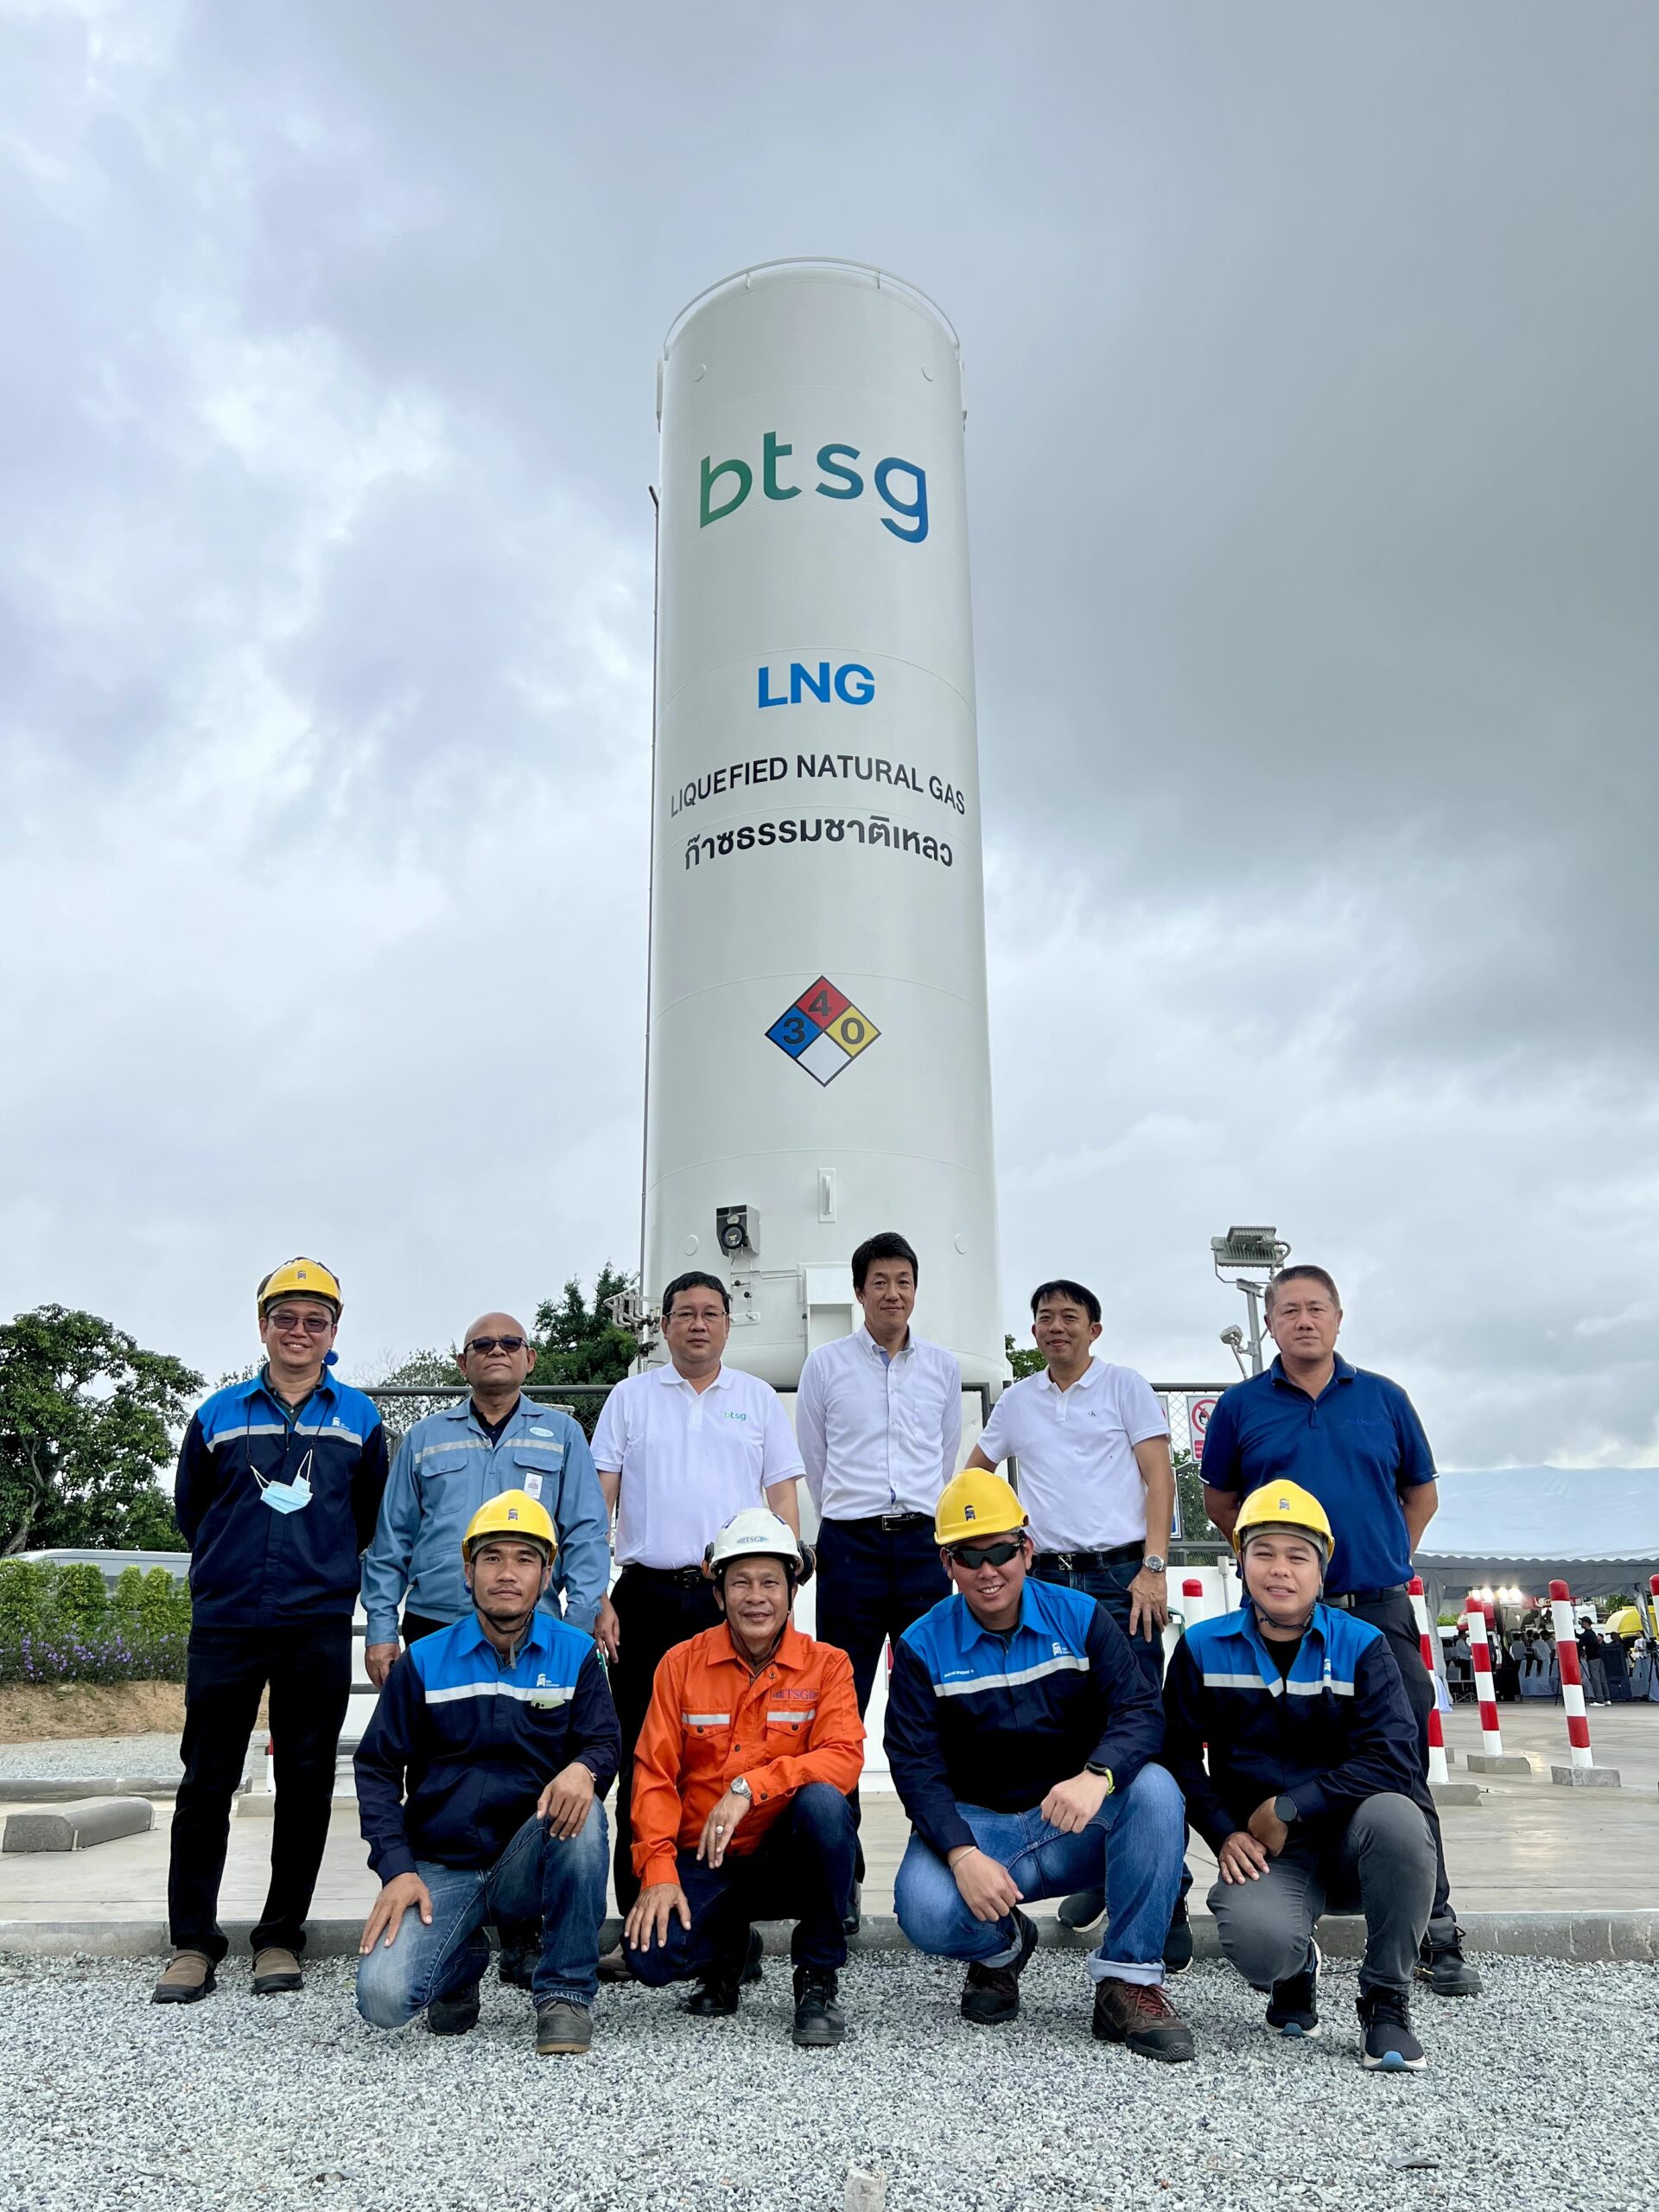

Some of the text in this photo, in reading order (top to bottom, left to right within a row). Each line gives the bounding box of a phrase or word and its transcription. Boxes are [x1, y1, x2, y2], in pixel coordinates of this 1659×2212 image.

[700, 431, 929, 543] btsg
[758, 662, 875, 708] LNG
[671, 754, 966, 817] LIQUEFIED NATURAL GAS
[685, 815, 953, 870] ก๊าซธรรมชาติเหลว
[808, 989, 832, 1017] 4
[783, 1017, 806, 1045] 3
[840, 1017, 865, 1045] 0
[724, 1411, 747, 1421] btsg
